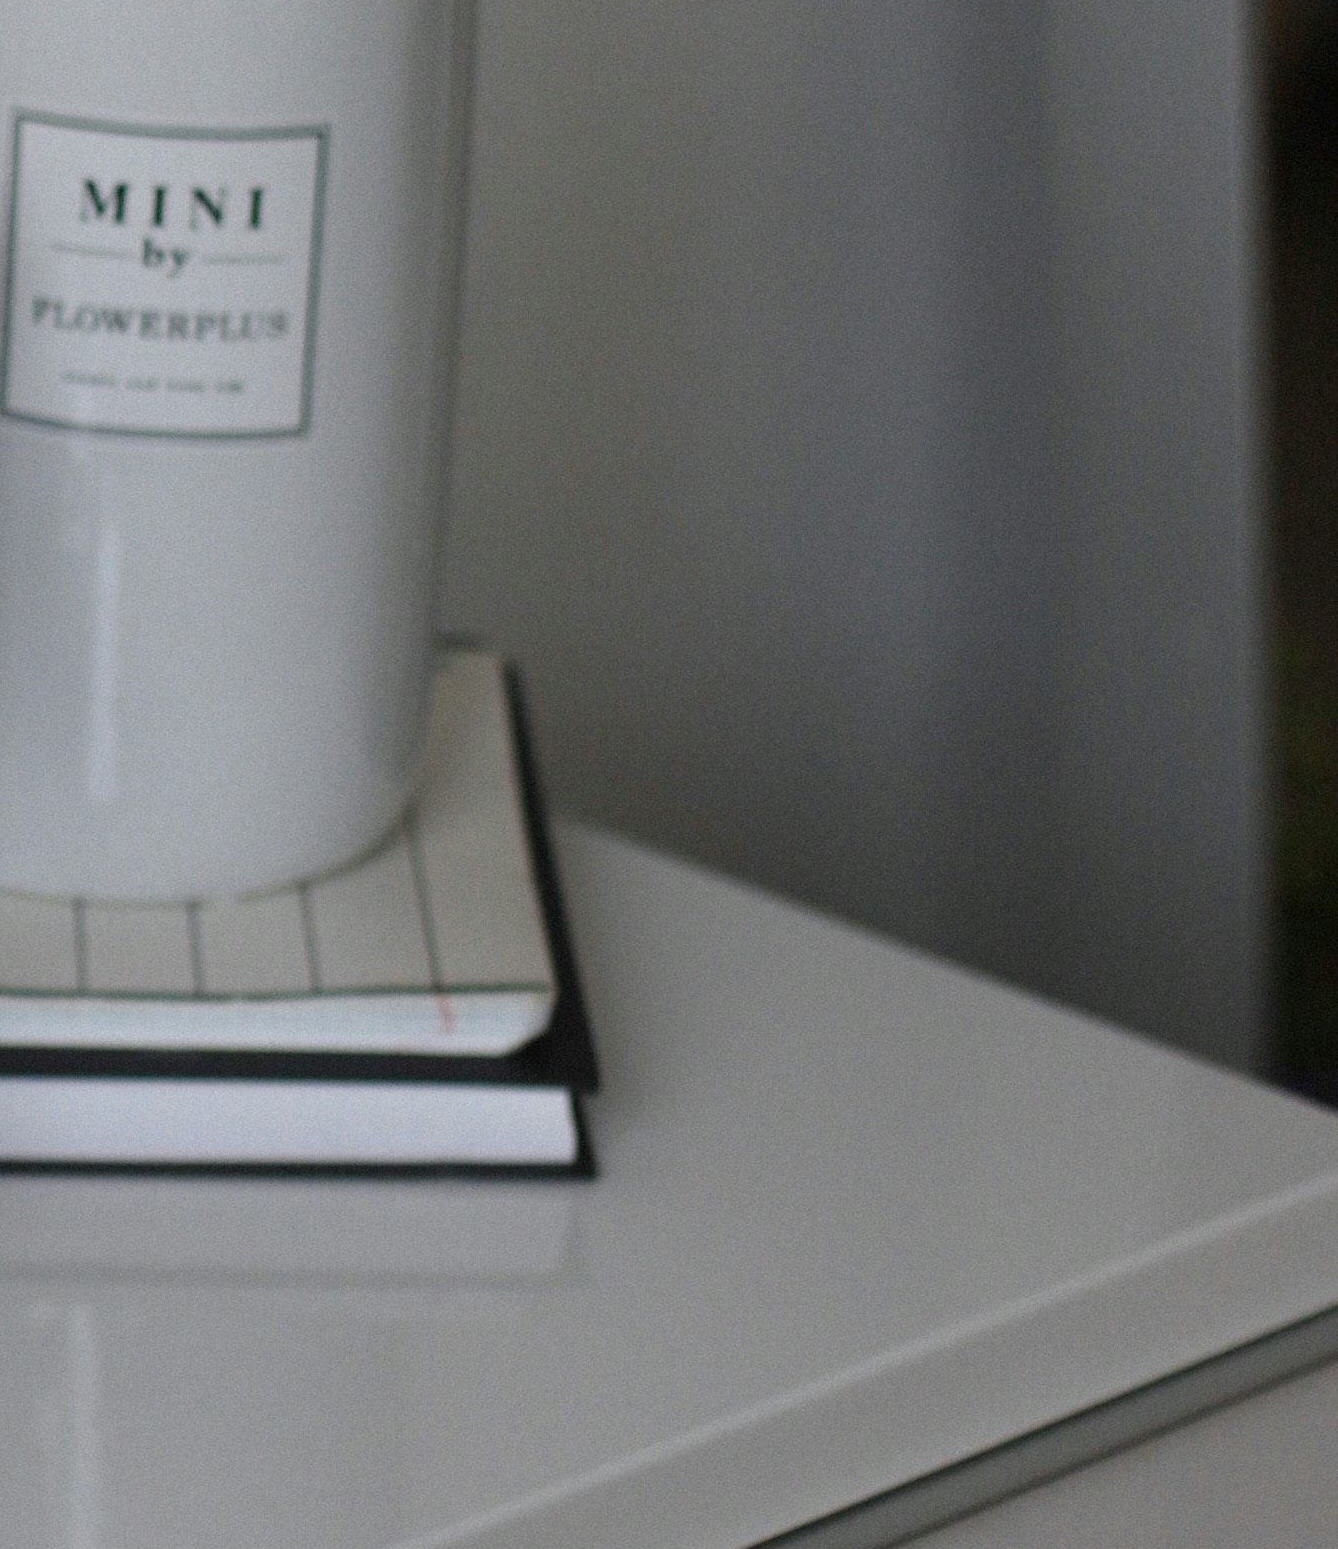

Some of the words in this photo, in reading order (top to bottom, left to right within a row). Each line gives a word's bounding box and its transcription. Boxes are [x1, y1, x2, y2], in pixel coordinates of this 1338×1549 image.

[78, 177, 265, 231] MINI
[141, 233, 189, 280] by
[31, 296, 289, 342] FLOWERPLUS
